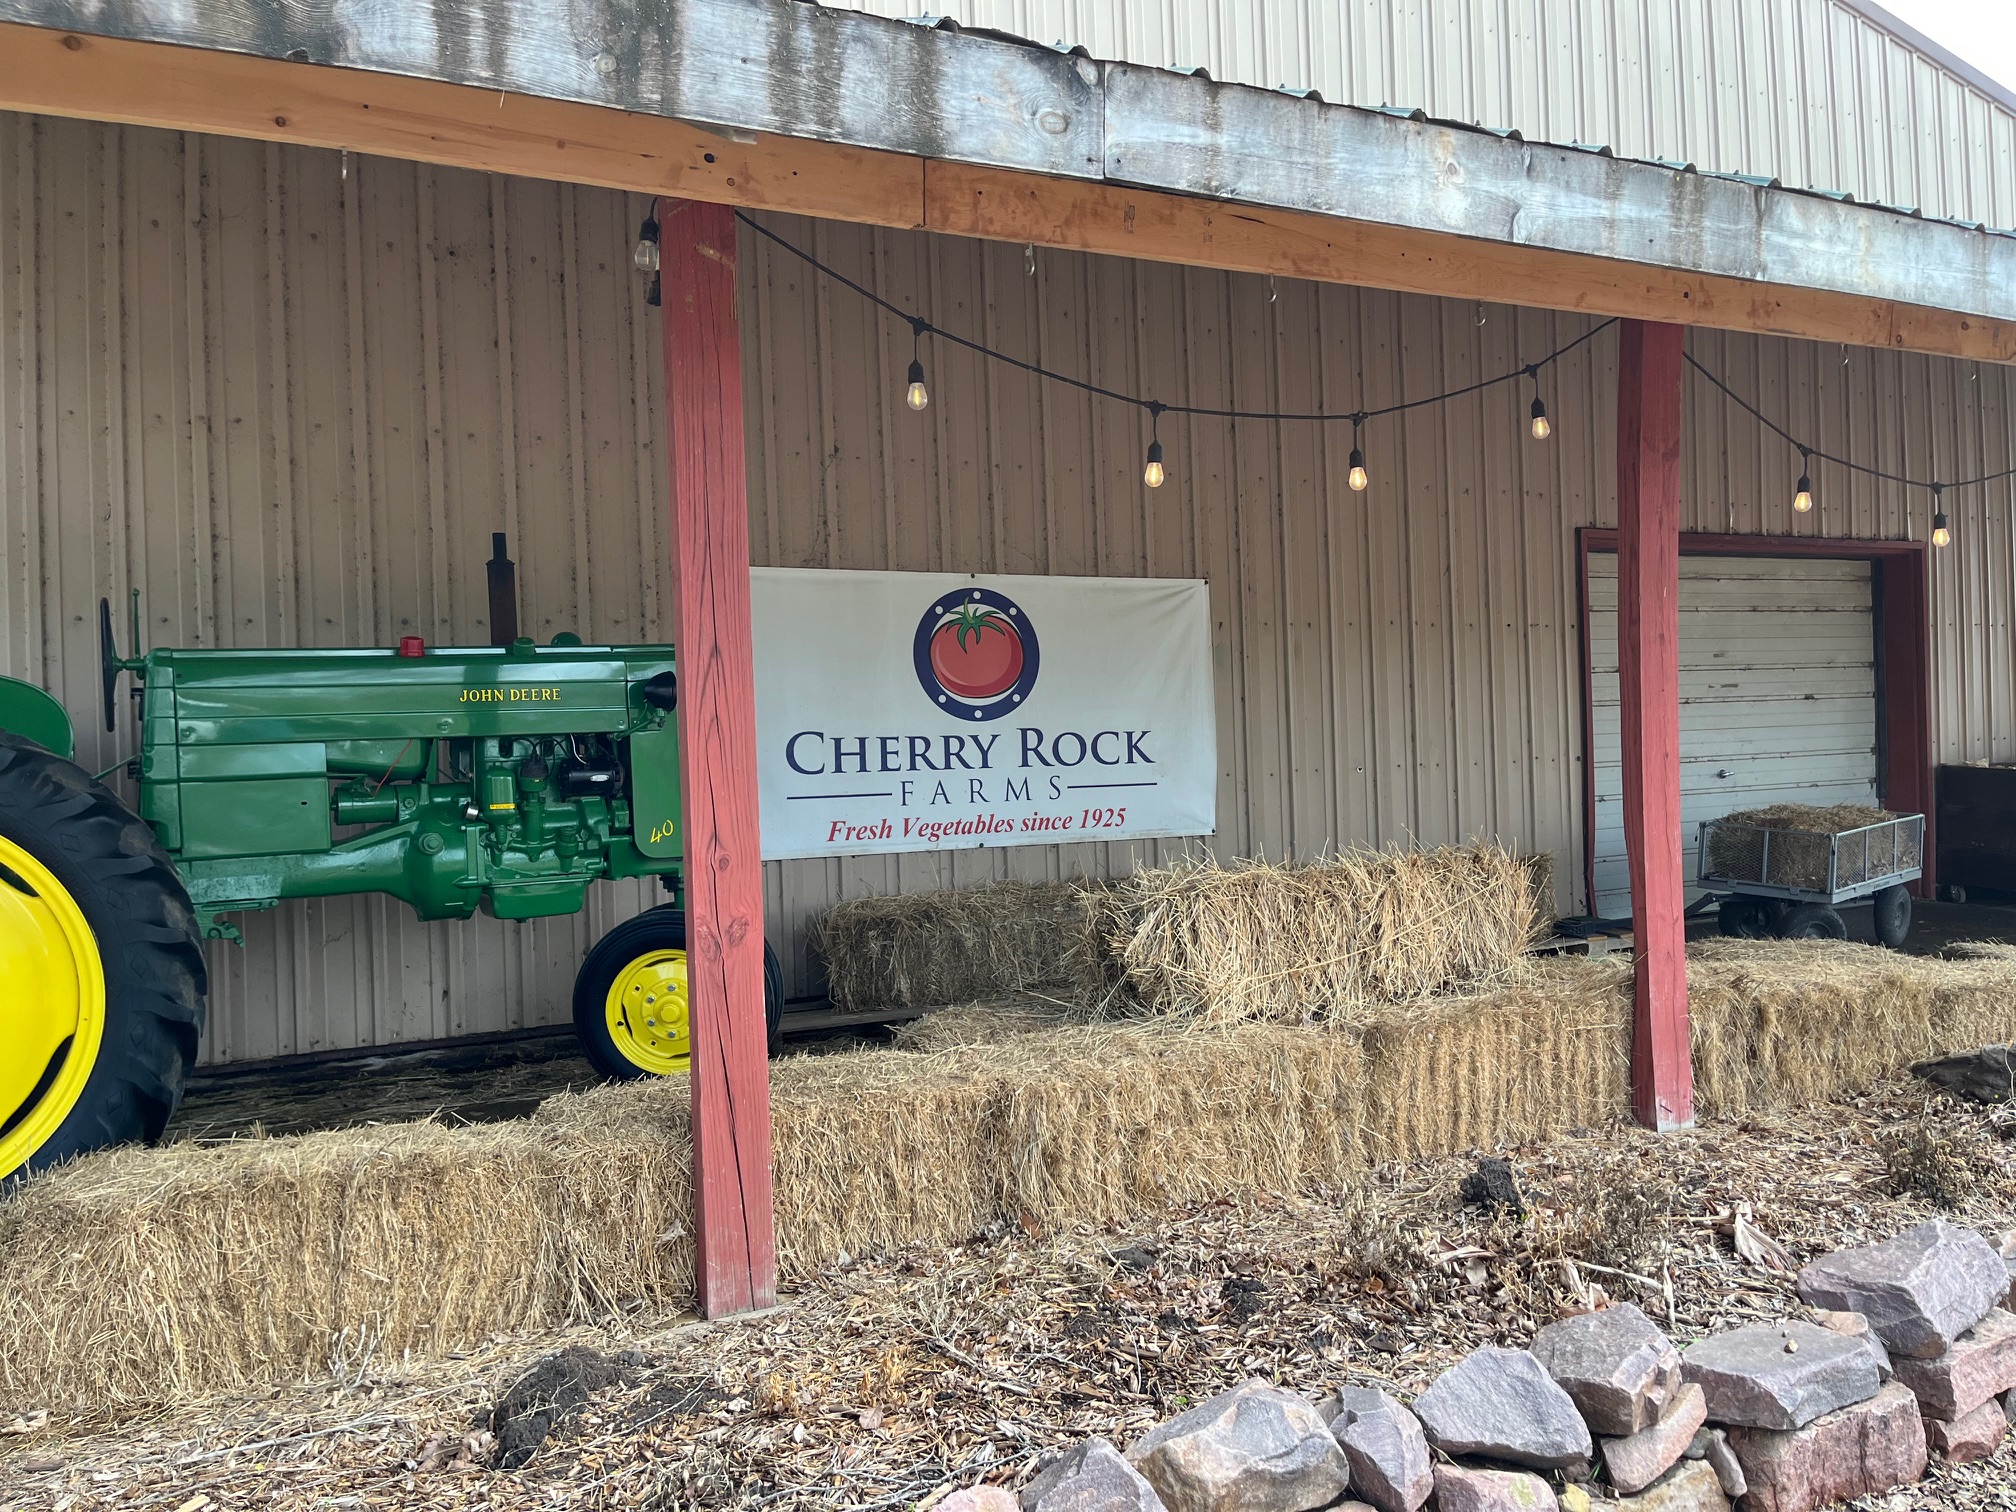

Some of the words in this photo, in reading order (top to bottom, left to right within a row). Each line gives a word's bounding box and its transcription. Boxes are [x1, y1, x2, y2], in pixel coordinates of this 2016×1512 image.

[460, 689, 504, 703] JOHN
[510, 688, 561, 701] DEERE
[785, 730, 1001, 775] CHERRY
[1016, 727, 1155, 769] ROCK
[900, 775, 1062, 806] FARMS
[650, 819, 674, 843] 40
[827, 817, 893, 842] Fresh
[902, 813, 1014, 842] Vegetables
[1020, 812, 1073, 833] since
[1080, 807, 1127, 829] 1925
